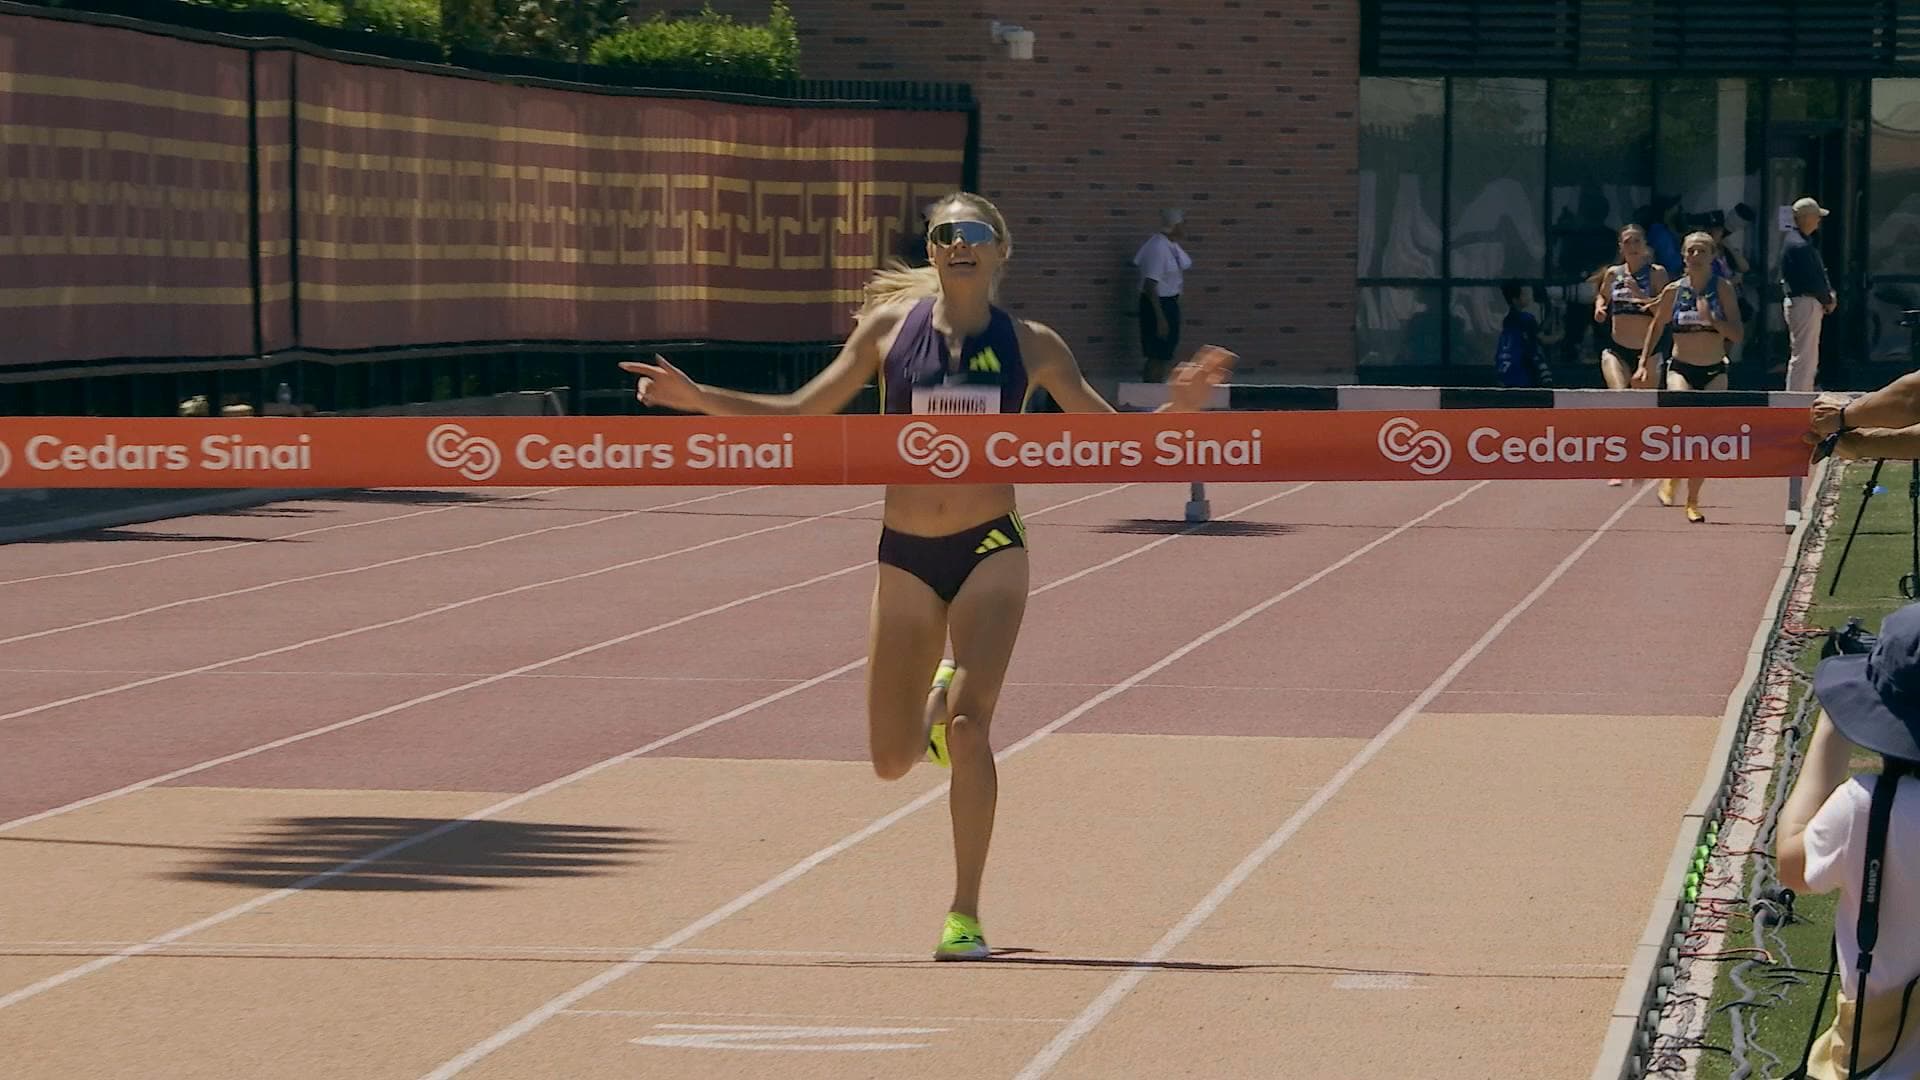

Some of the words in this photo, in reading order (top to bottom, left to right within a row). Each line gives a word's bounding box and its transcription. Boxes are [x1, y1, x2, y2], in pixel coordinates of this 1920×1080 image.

[25, 433, 189, 470] Cedars
[201, 433, 311, 470] Sinai
[516, 432, 674, 470] Cedars
[686, 431, 793, 469] Sinai
[985, 430, 1142, 467] Cedars
[1154, 428, 1262, 466] Sinai
[1467, 425, 1627, 464] Cedars
[1640, 423, 1751, 462] Sinai
[1867, 859, 1881, 903] Canon
